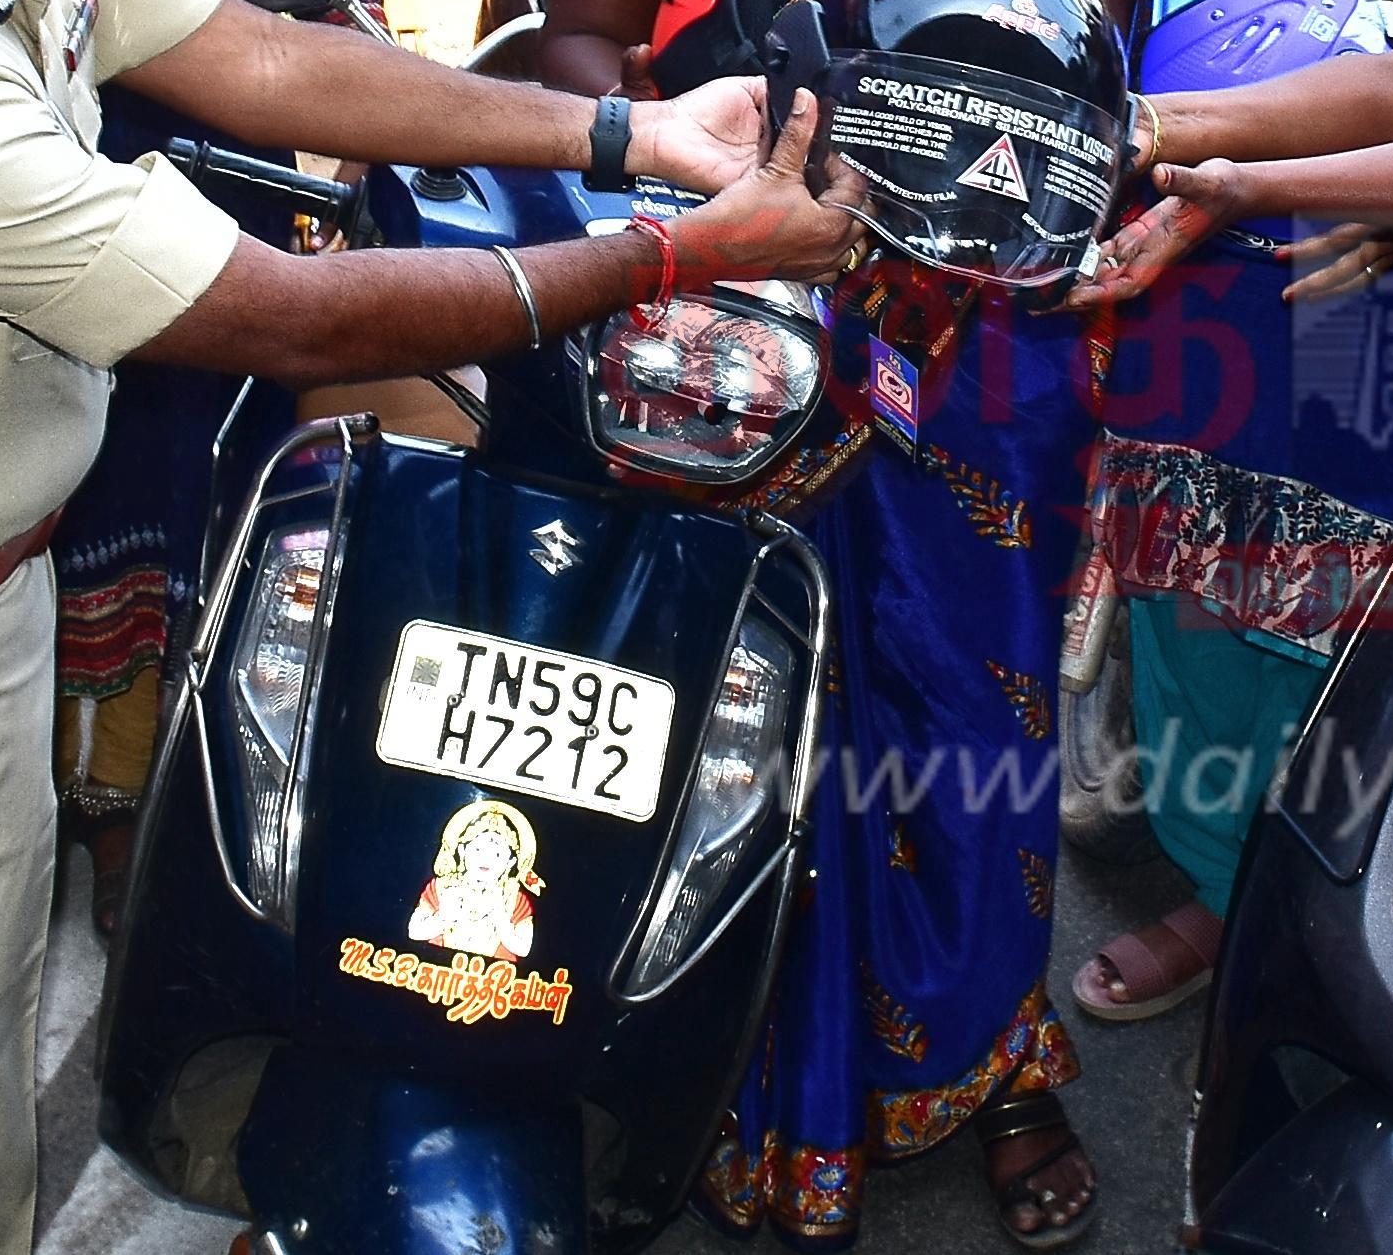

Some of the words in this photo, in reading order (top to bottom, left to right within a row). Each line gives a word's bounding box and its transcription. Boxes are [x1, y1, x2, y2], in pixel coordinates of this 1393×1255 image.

[832, 114, 871, 127] FORMATION
[870, 120, 883, 128] OF
[882, 121, 933, 138] SCRATCHES
[932, 131, 954, 143] AND
[857, 76, 965, 110] SCRATCH
[965, 97, 1083, 146] RESISTANT
[874, 111, 895, 121] GOOD
[915, 118, 927, 126] OF
[887, 97, 991, 127] POLYCARBONATE
[994, 120, 1041, 142] SILICON
[1039, 131, 1069, 153] HARD
[870, 138, 900, 151] SHOULD
[899, 144, 911, 153] BE
[882, 131, 896, 139] OF
[895, 133, 915, 143] DIRT
[915, 138, 929, 147] ON
[929, 140, 948, 151] THE
[838, 151, 867, 174] REMOVE
[865, 167, 884, 184] THIS
[881, 179, 935, 203] PROTECTIVE
[456, 641, 639, 738] TN59C
[437, 708, 631, 801] H7212
